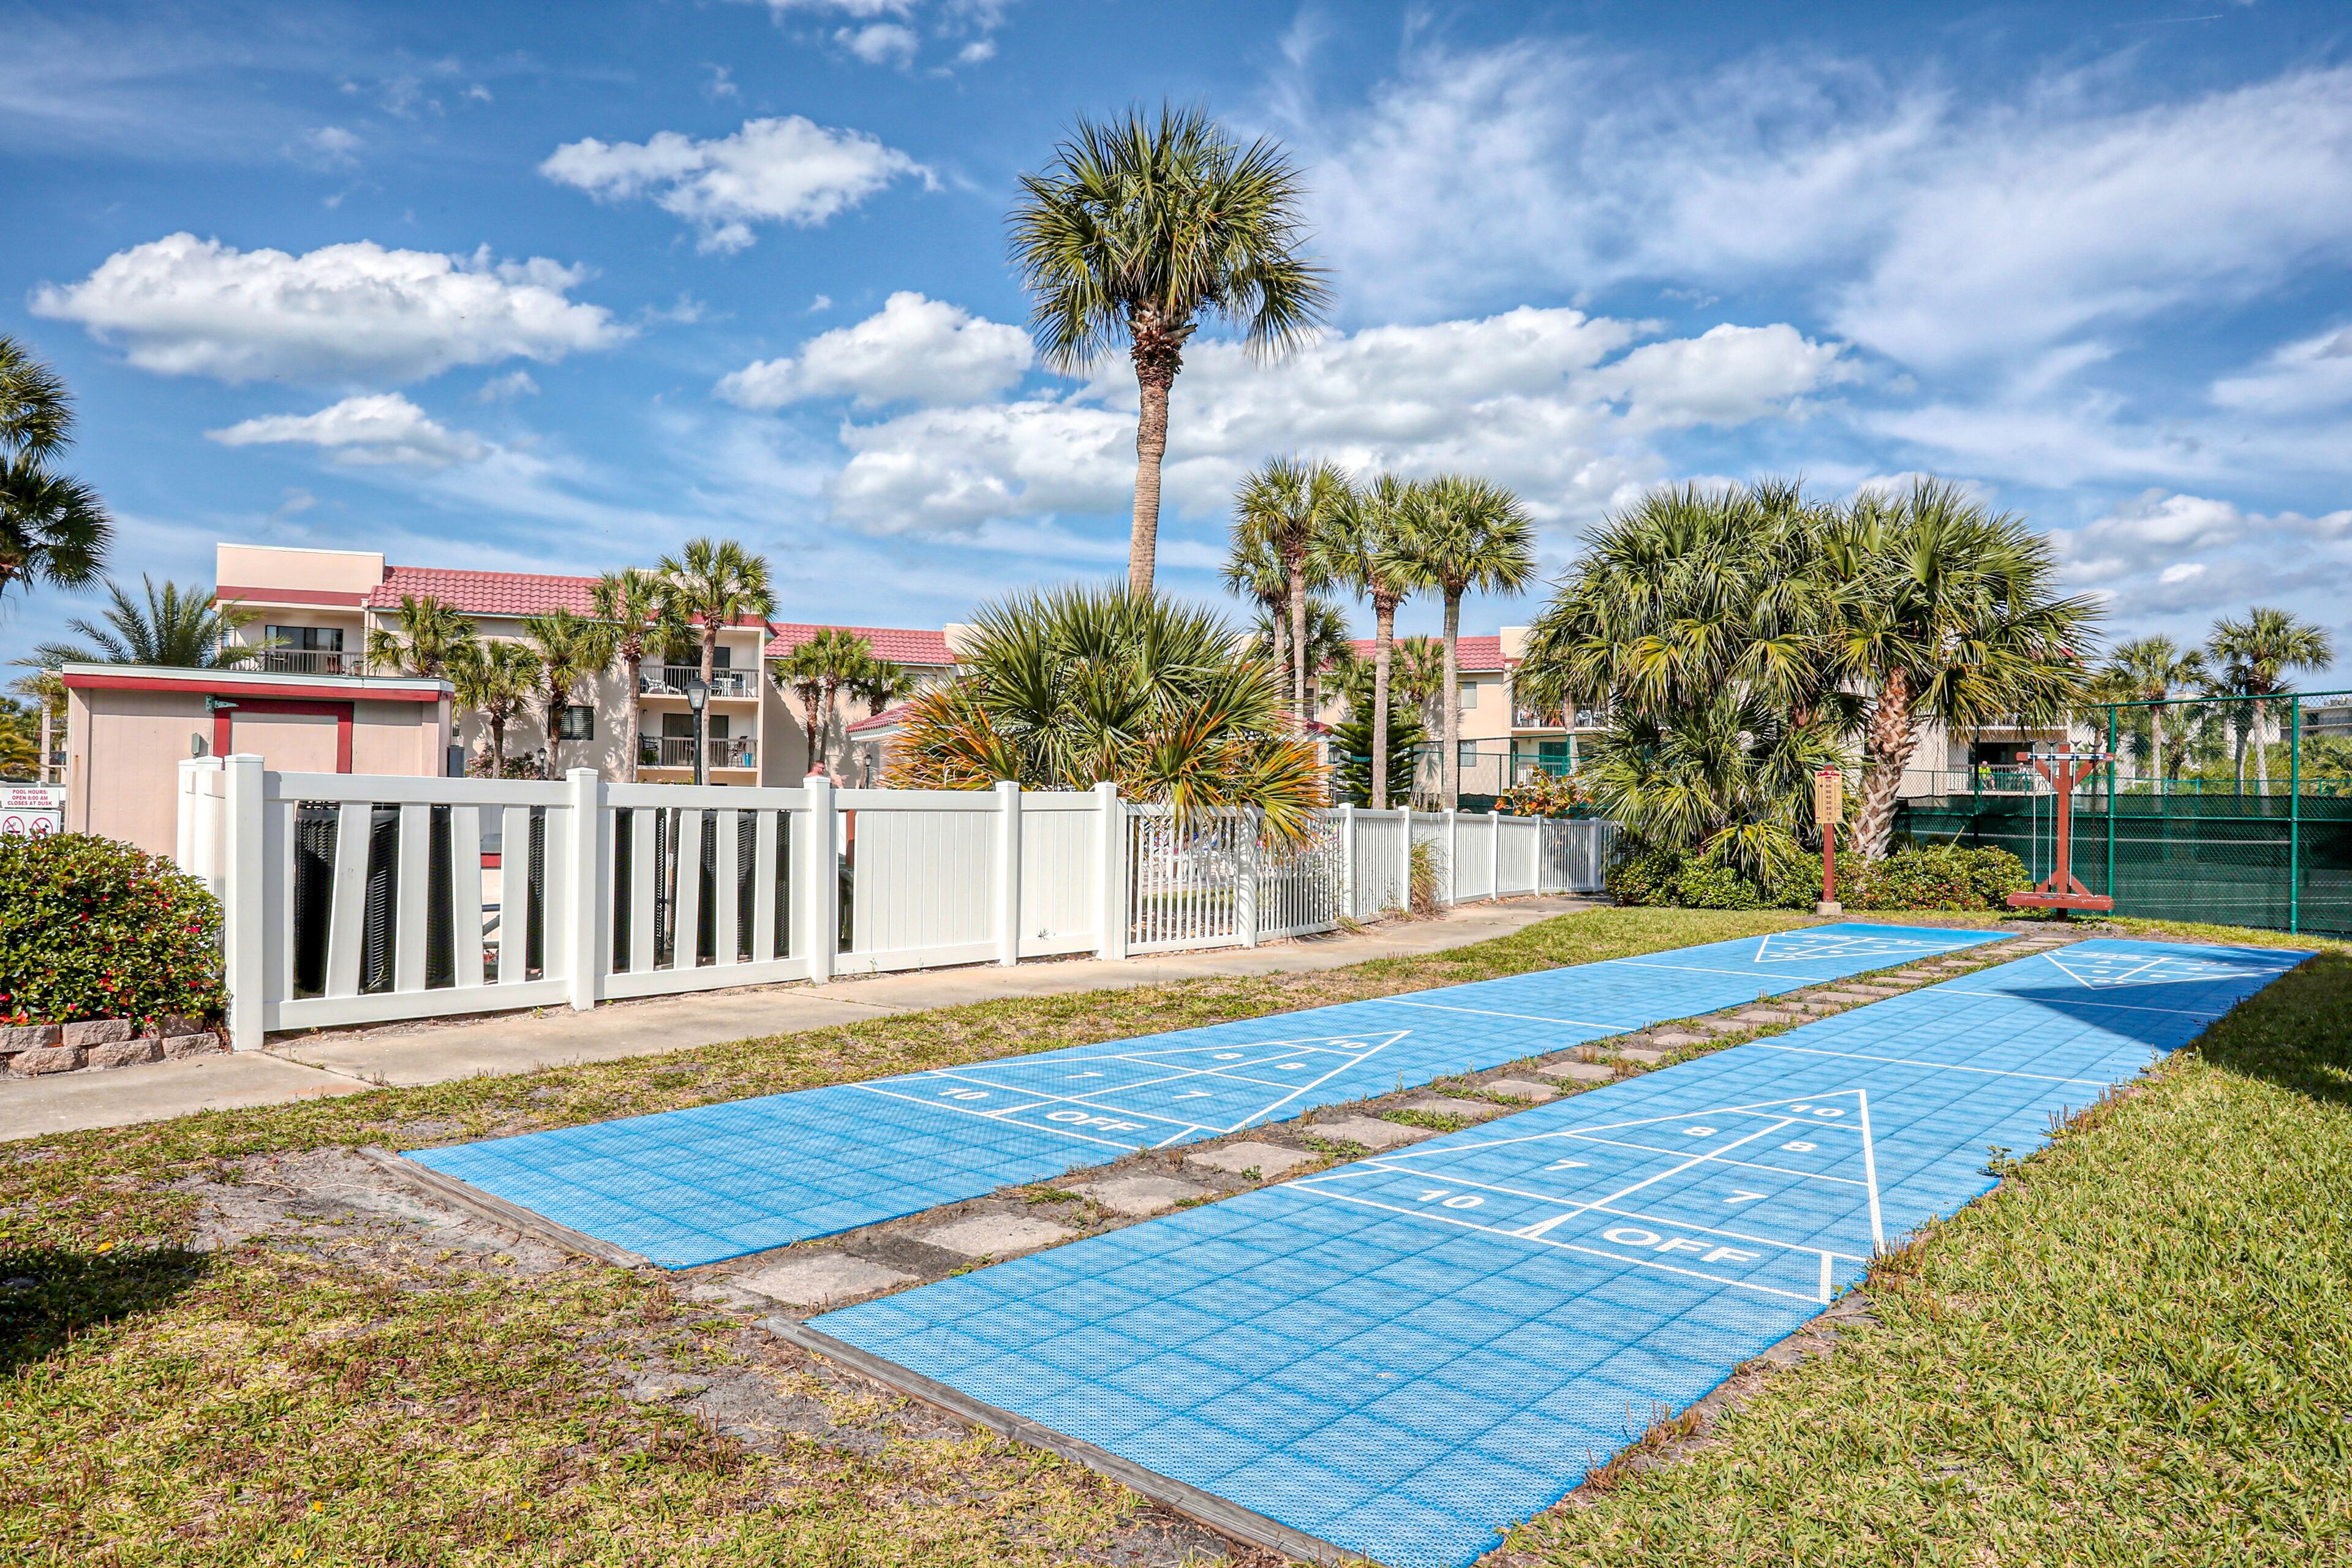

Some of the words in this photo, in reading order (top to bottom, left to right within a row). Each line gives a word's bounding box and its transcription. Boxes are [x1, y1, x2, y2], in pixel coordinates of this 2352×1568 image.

[1326, 1040, 1368, 1049] 10
[938, 1088, 990, 1100] 10
[1172, 1090, 1213, 1099] 7
[1789, 1104, 1845, 1117] 10
[1045, 1110, 1147, 1131] OFF
[1682, 1126, 1718, 1137] 8
[1781, 1141, 1818, 1152] 8
[1545, 1159, 1589, 1171] 7
[1417, 1189, 1485, 1209] 10
[1722, 1189, 1769, 1204] 7
[1602, 1227, 1762, 1262] OFF
